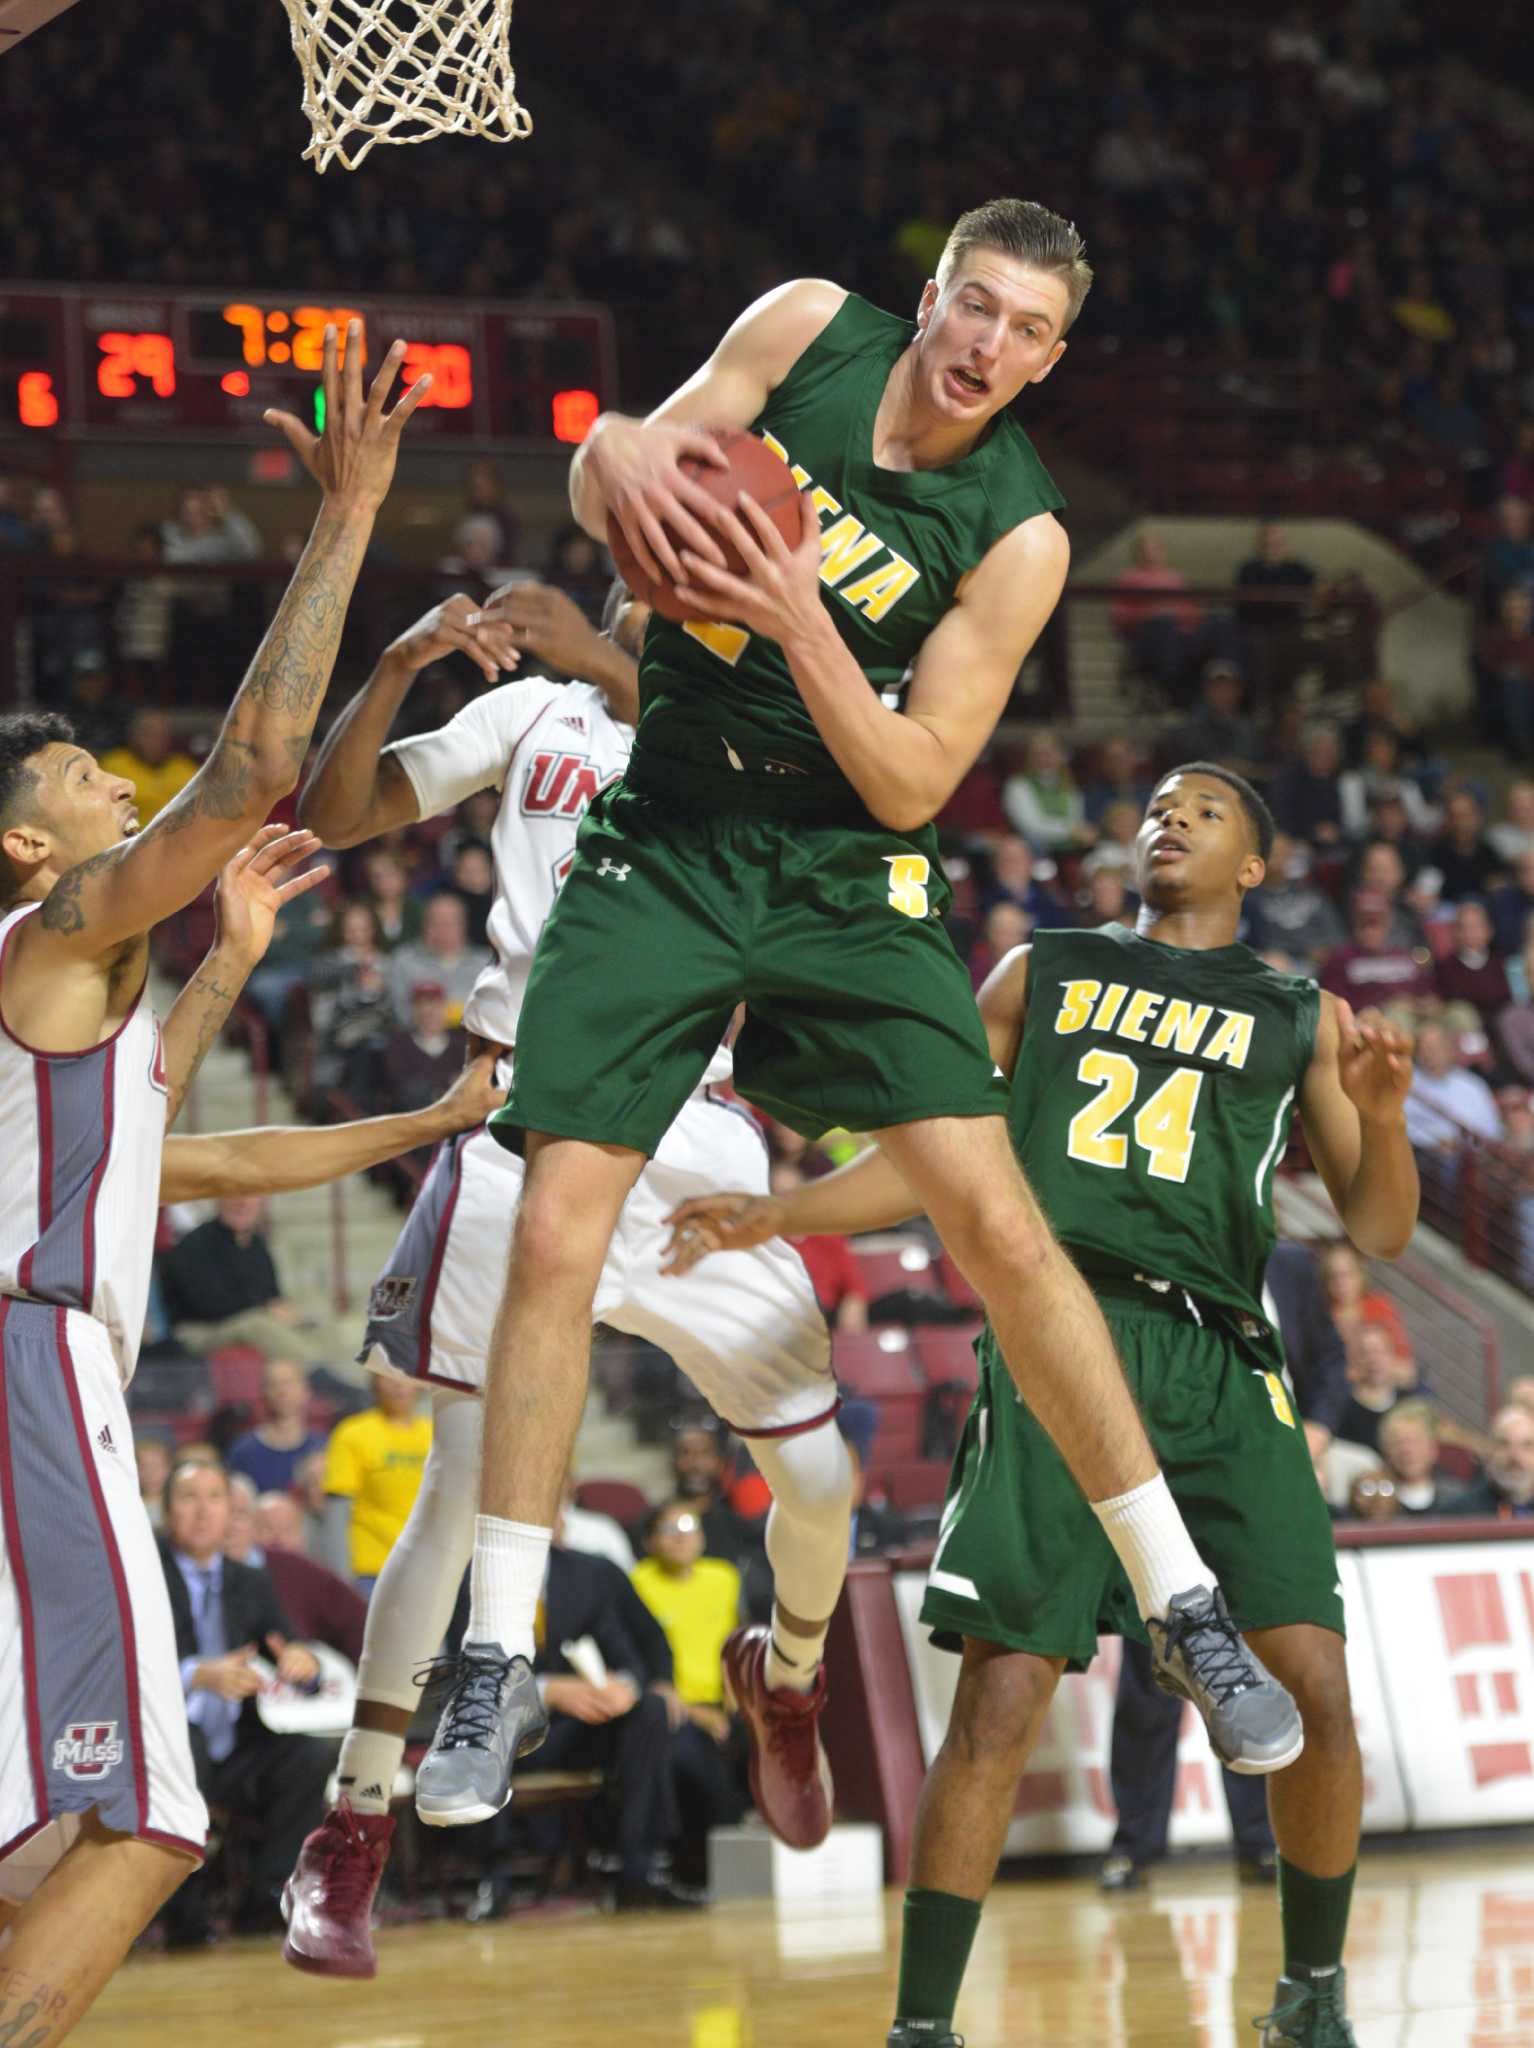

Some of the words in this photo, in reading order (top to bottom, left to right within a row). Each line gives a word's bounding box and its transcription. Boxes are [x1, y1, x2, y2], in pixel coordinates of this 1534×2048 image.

[97, 330, 176, 398] 29
[1055, 979, 1256, 1069] SIENA
[1067, 1047, 1204, 1184] 24
